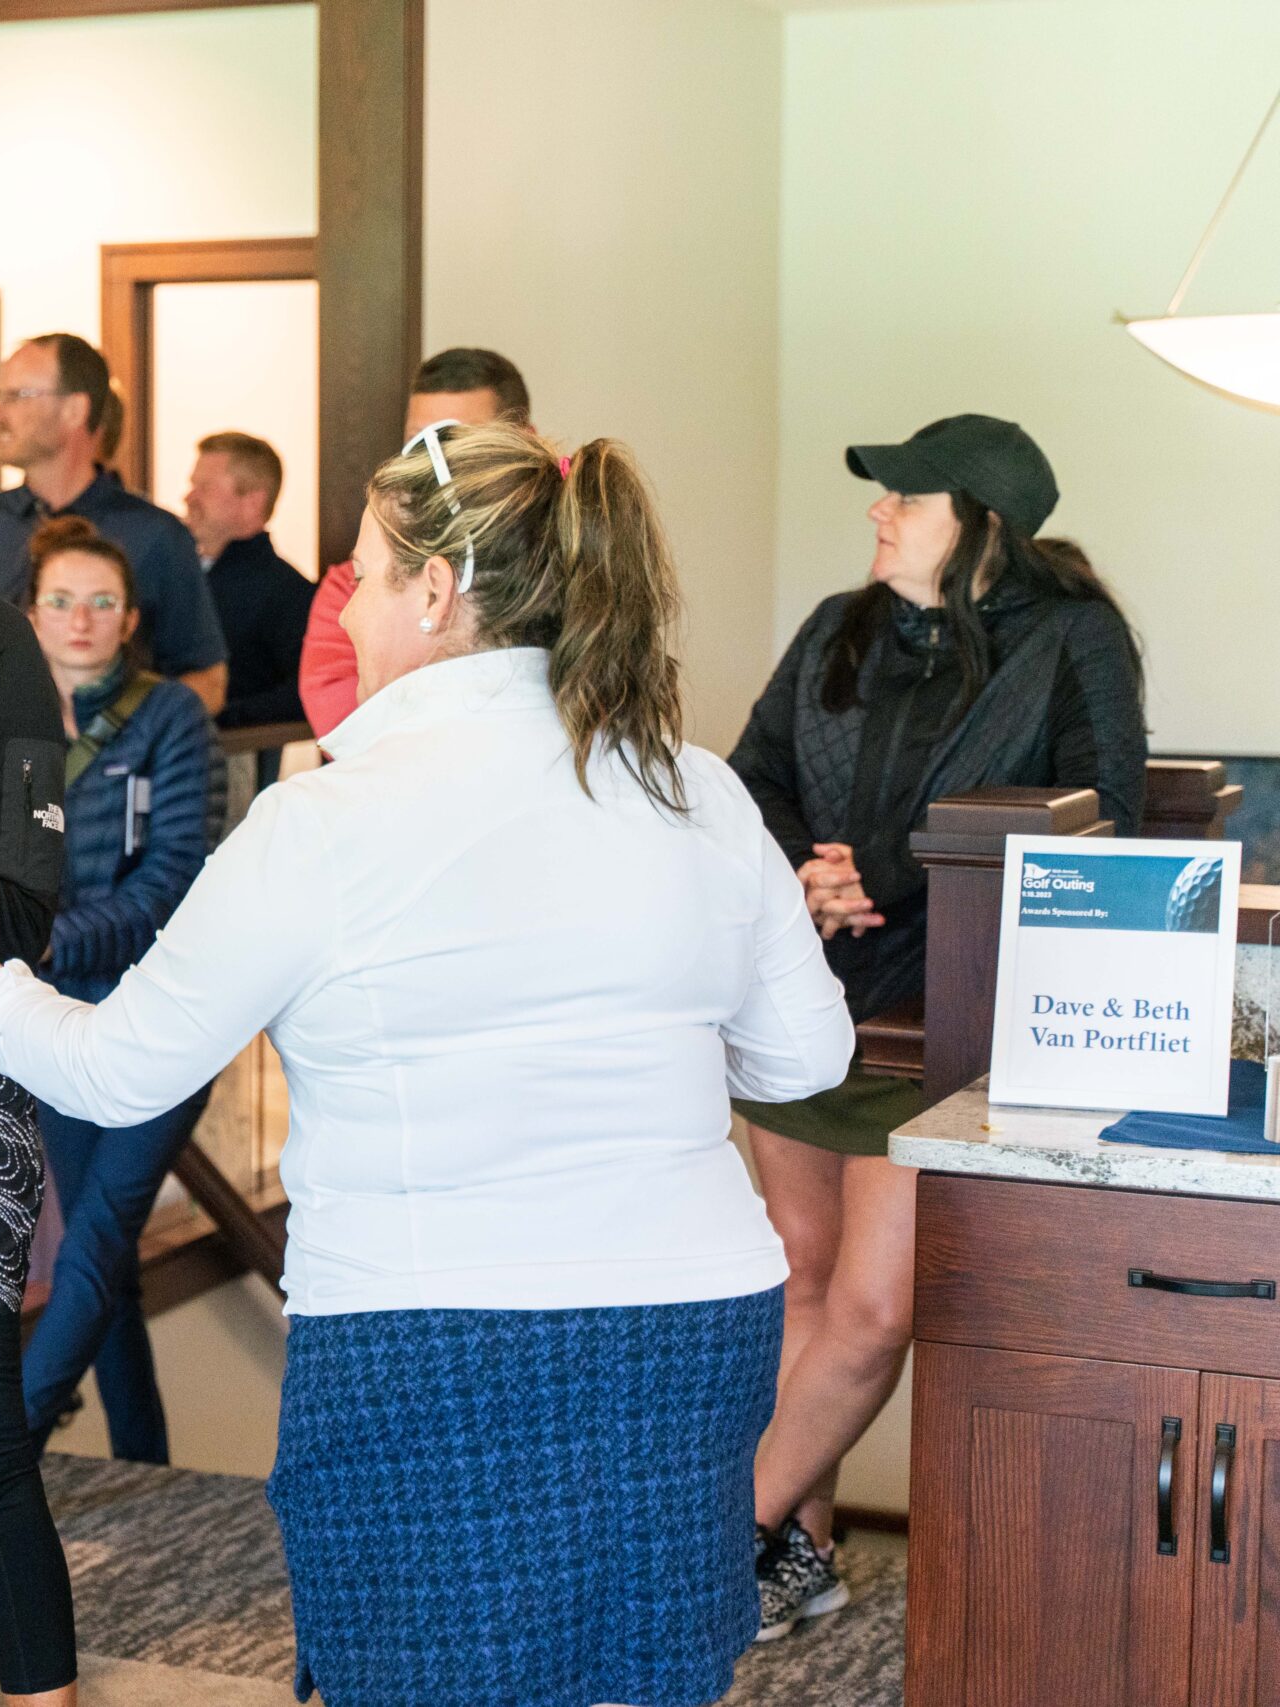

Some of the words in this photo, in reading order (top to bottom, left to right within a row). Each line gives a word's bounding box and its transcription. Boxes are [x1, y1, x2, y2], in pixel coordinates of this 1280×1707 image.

[1022, 878, 1051, 889] Golf
[1052, 878, 1095, 893] Outing
[1021, 906, 1051, 916] Awards
[1051, 908, 1094, 918] Sponsored
[1094, 909, 1109, 919] By:
[1032, 994, 1094, 1016] Dave
[1102, 998, 1124, 1018] &
[1133, 998, 1191, 1021] Beth
[1029, 1026, 1075, 1048] Van
[1082, 1029, 1192, 1053] Portfliet
